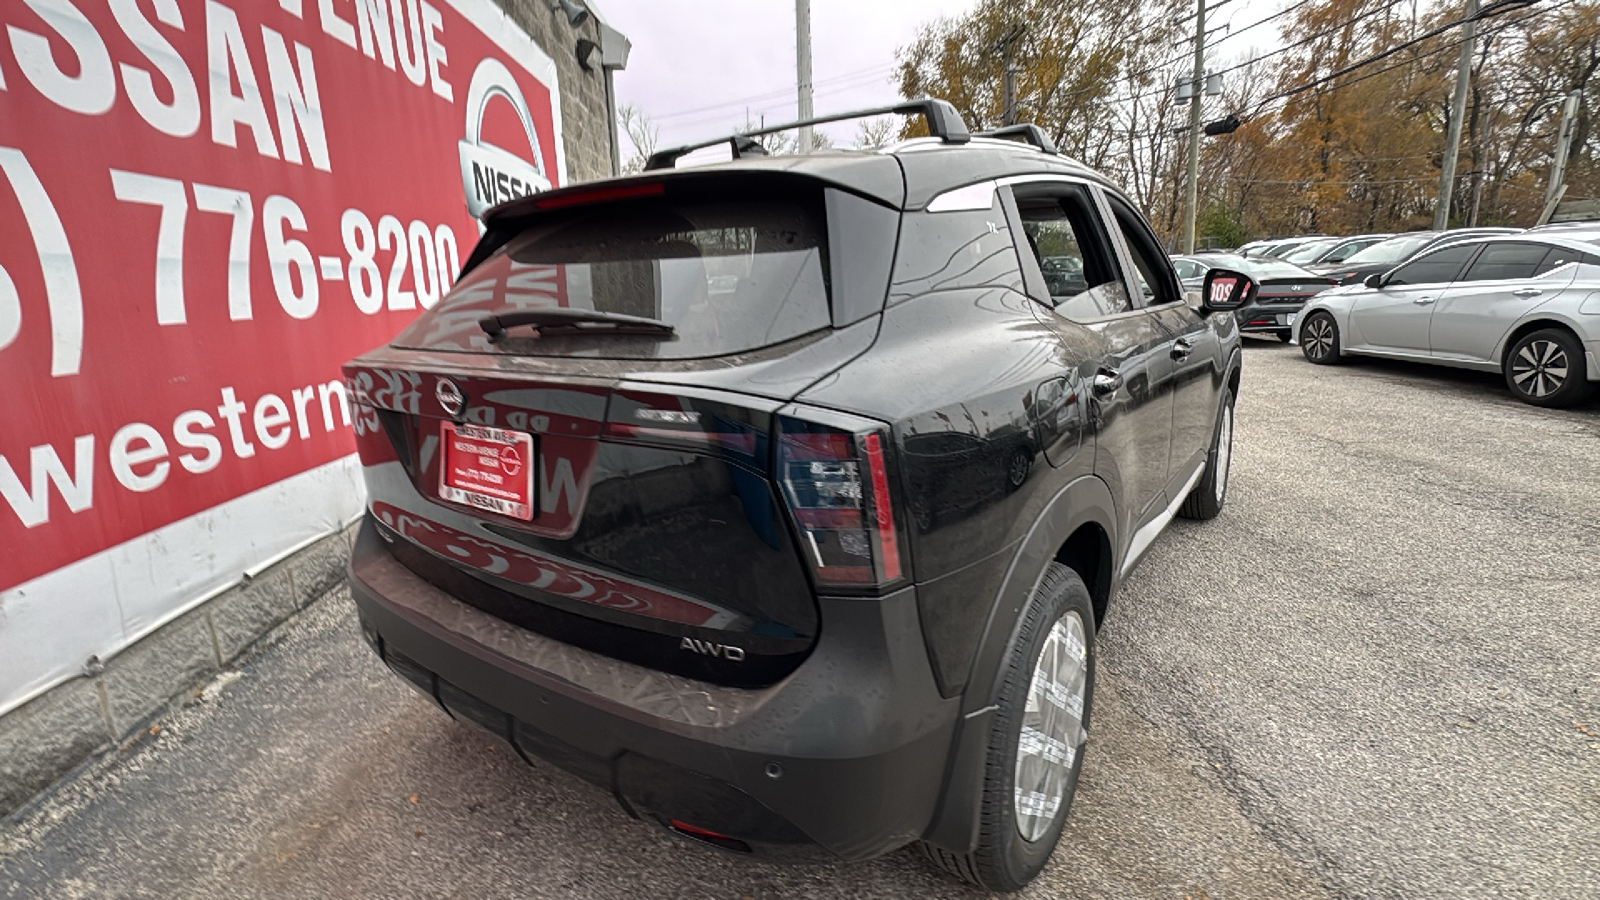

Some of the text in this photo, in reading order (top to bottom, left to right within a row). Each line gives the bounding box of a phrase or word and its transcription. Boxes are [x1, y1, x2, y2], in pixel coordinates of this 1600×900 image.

[0, 0, 332, 173] SSAN
[472, 160, 546, 206] NISS
[109, 168, 460, 326] 776-8200
[464, 492, 504, 512] NISSAN
[680, 636, 746, 661] AWD
